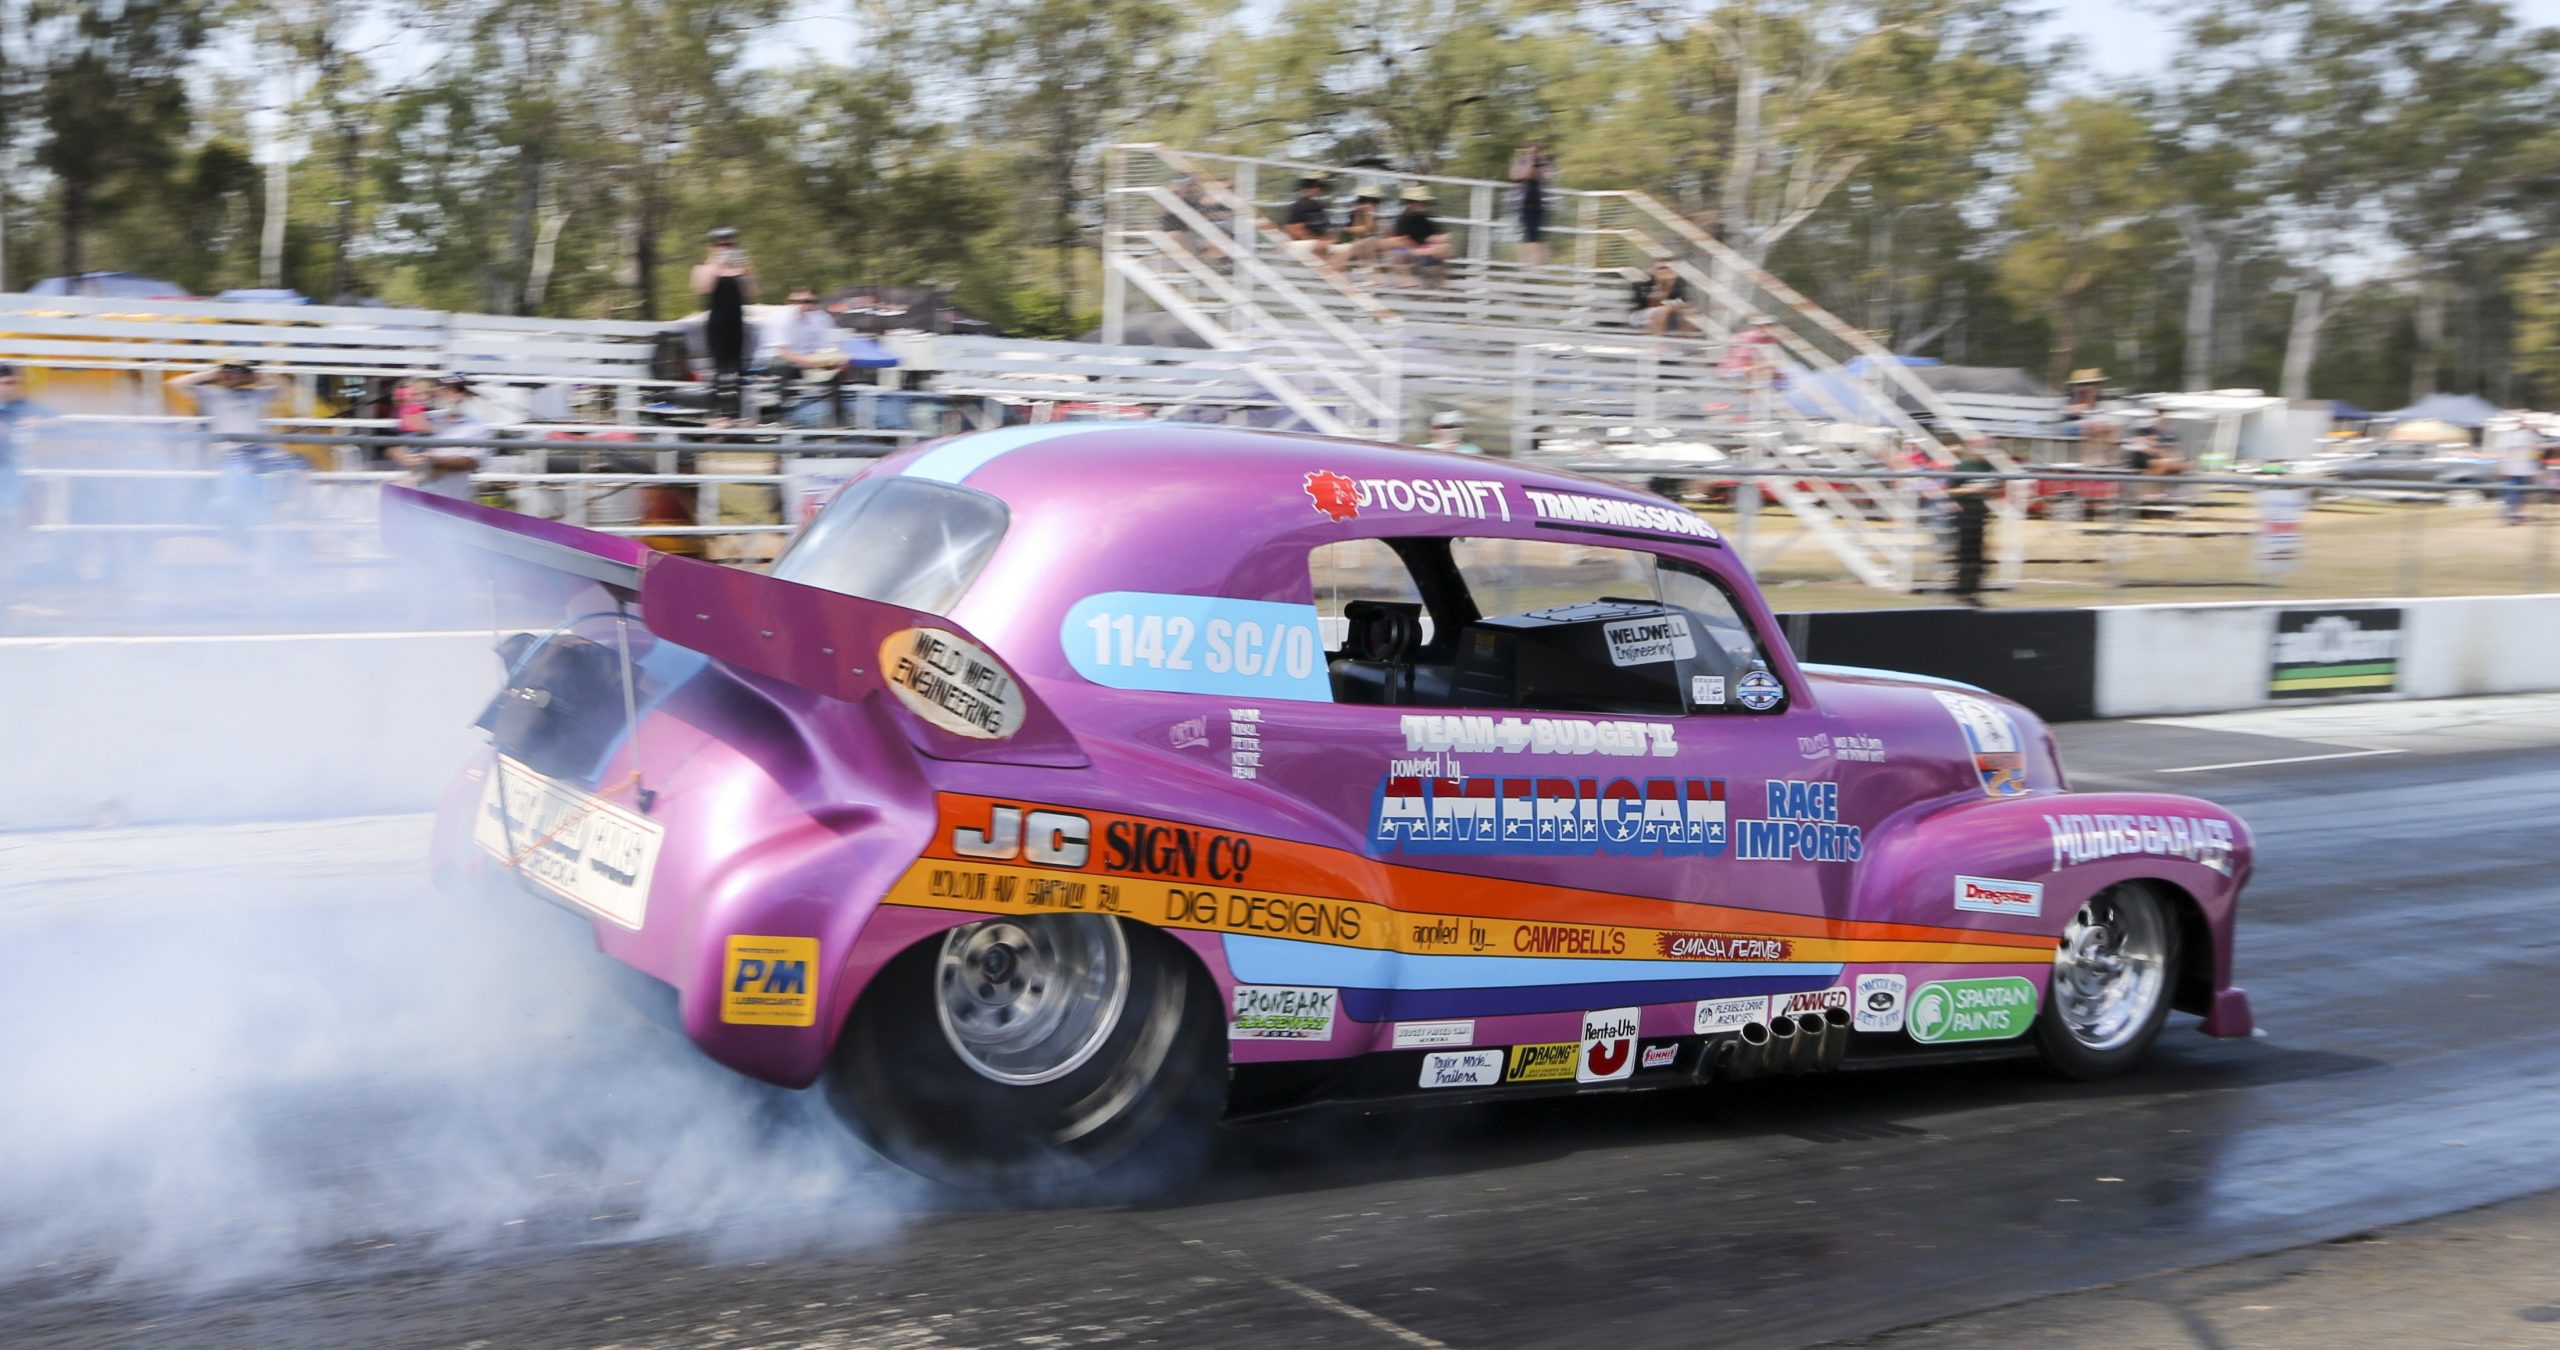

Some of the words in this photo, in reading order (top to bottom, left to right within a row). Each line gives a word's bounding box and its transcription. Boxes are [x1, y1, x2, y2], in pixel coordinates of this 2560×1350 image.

[1525, 491, 1719, 540] TRANSMISSIONS
[1087, 612, 1196, 671] 1142
[1608, 622, 1688, 645] WELDWELL
[891, 655, 1004, 735] ENGINEERING
[1401, 714, 1495, 753] TEAM
[1531, 718, 1648, 757] BUDGET
[1374, 776, 1728, 848] AMERICAN
[1765, 779, 1839, 823] RACE
[953, 803, 1092, 869] JC
[1103, 820, 1200, 879] SIGN
[1735, 819, 1862, 863] IMPORTS
[1965, 882, 2033, 905] Dragster
[1166, 888, 1218, 925] DIG
[1227, 894, 1361, 941] DESIGNS
[1514, 925, 1626, 955] CAMPBELL'S
[1670, 937, 1726, 958] SMASH
[731, 958, 807, 995] PM
[1237, 989, 1335, 1017] IRONBARK
[1714, 1002, 1746, 1014] FLEXIBLE
[1955, 985, 2030, 1009] SPARTAN
[1952, 1009, 2011, 1033] PAINTS
[1509, 1047, 1538, 1080] JP
[1536, 1045, 1572, 1061] RACING
